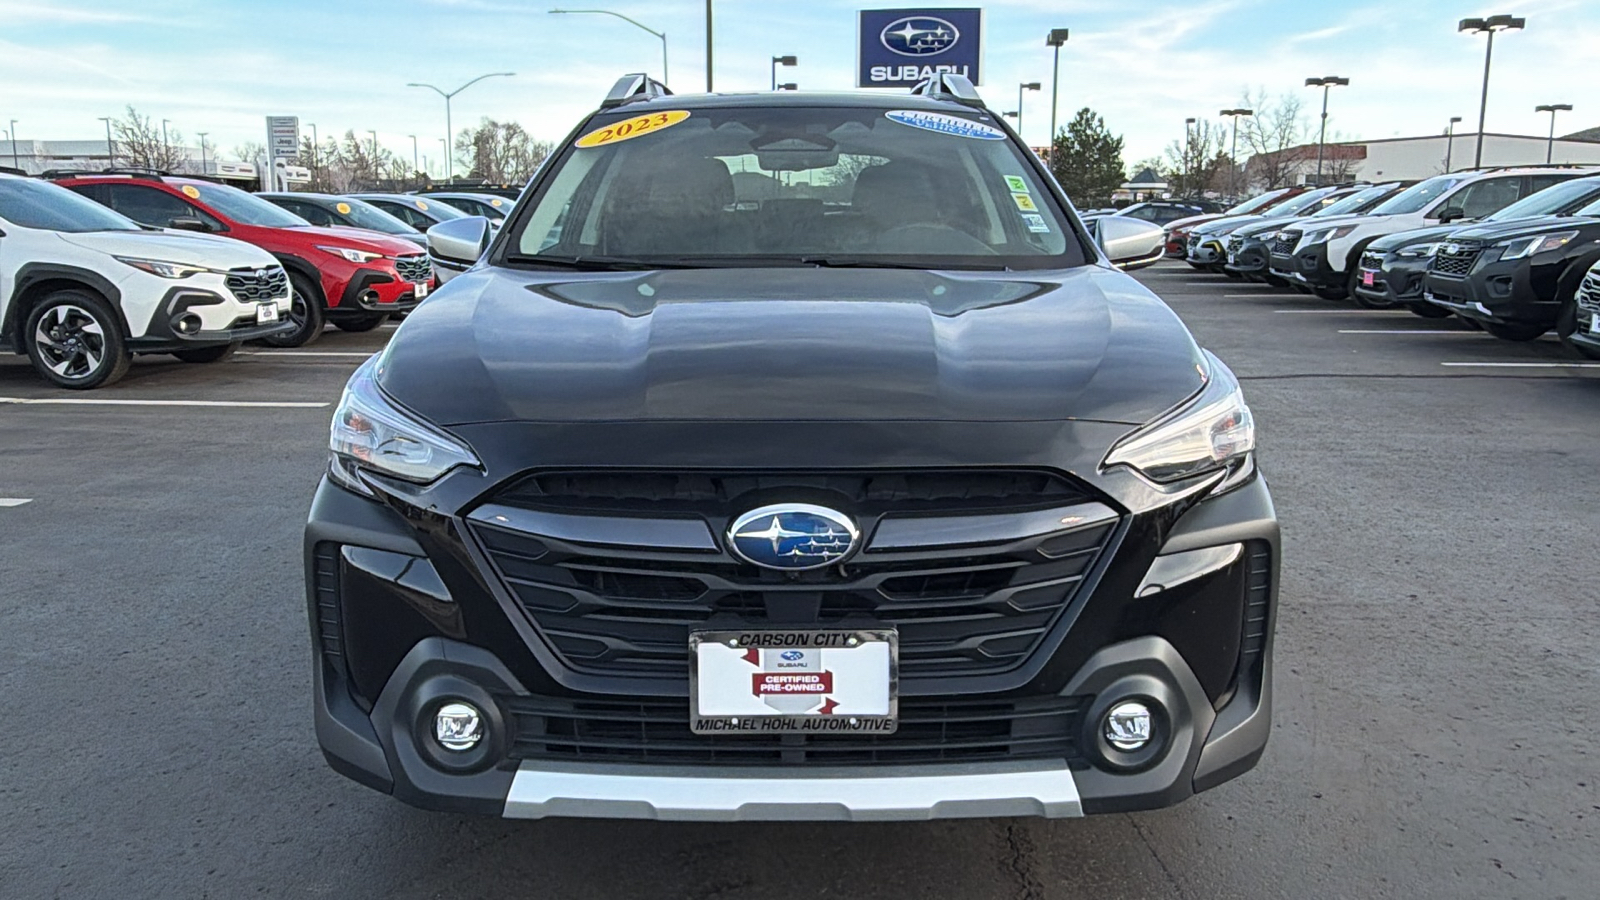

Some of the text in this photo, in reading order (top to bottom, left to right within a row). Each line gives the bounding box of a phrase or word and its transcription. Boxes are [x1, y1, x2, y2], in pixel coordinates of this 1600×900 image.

[598, 113, 668, 143] 2023
[739, 633, 852, 646] CARSON CITY
[765, 675, 820, 683] CERTIFIED
[760, 683, 825, 692] PRE-OWNED
[695, 718, 893, 731] MICHAEL HOHL AUTOMOTIVE
